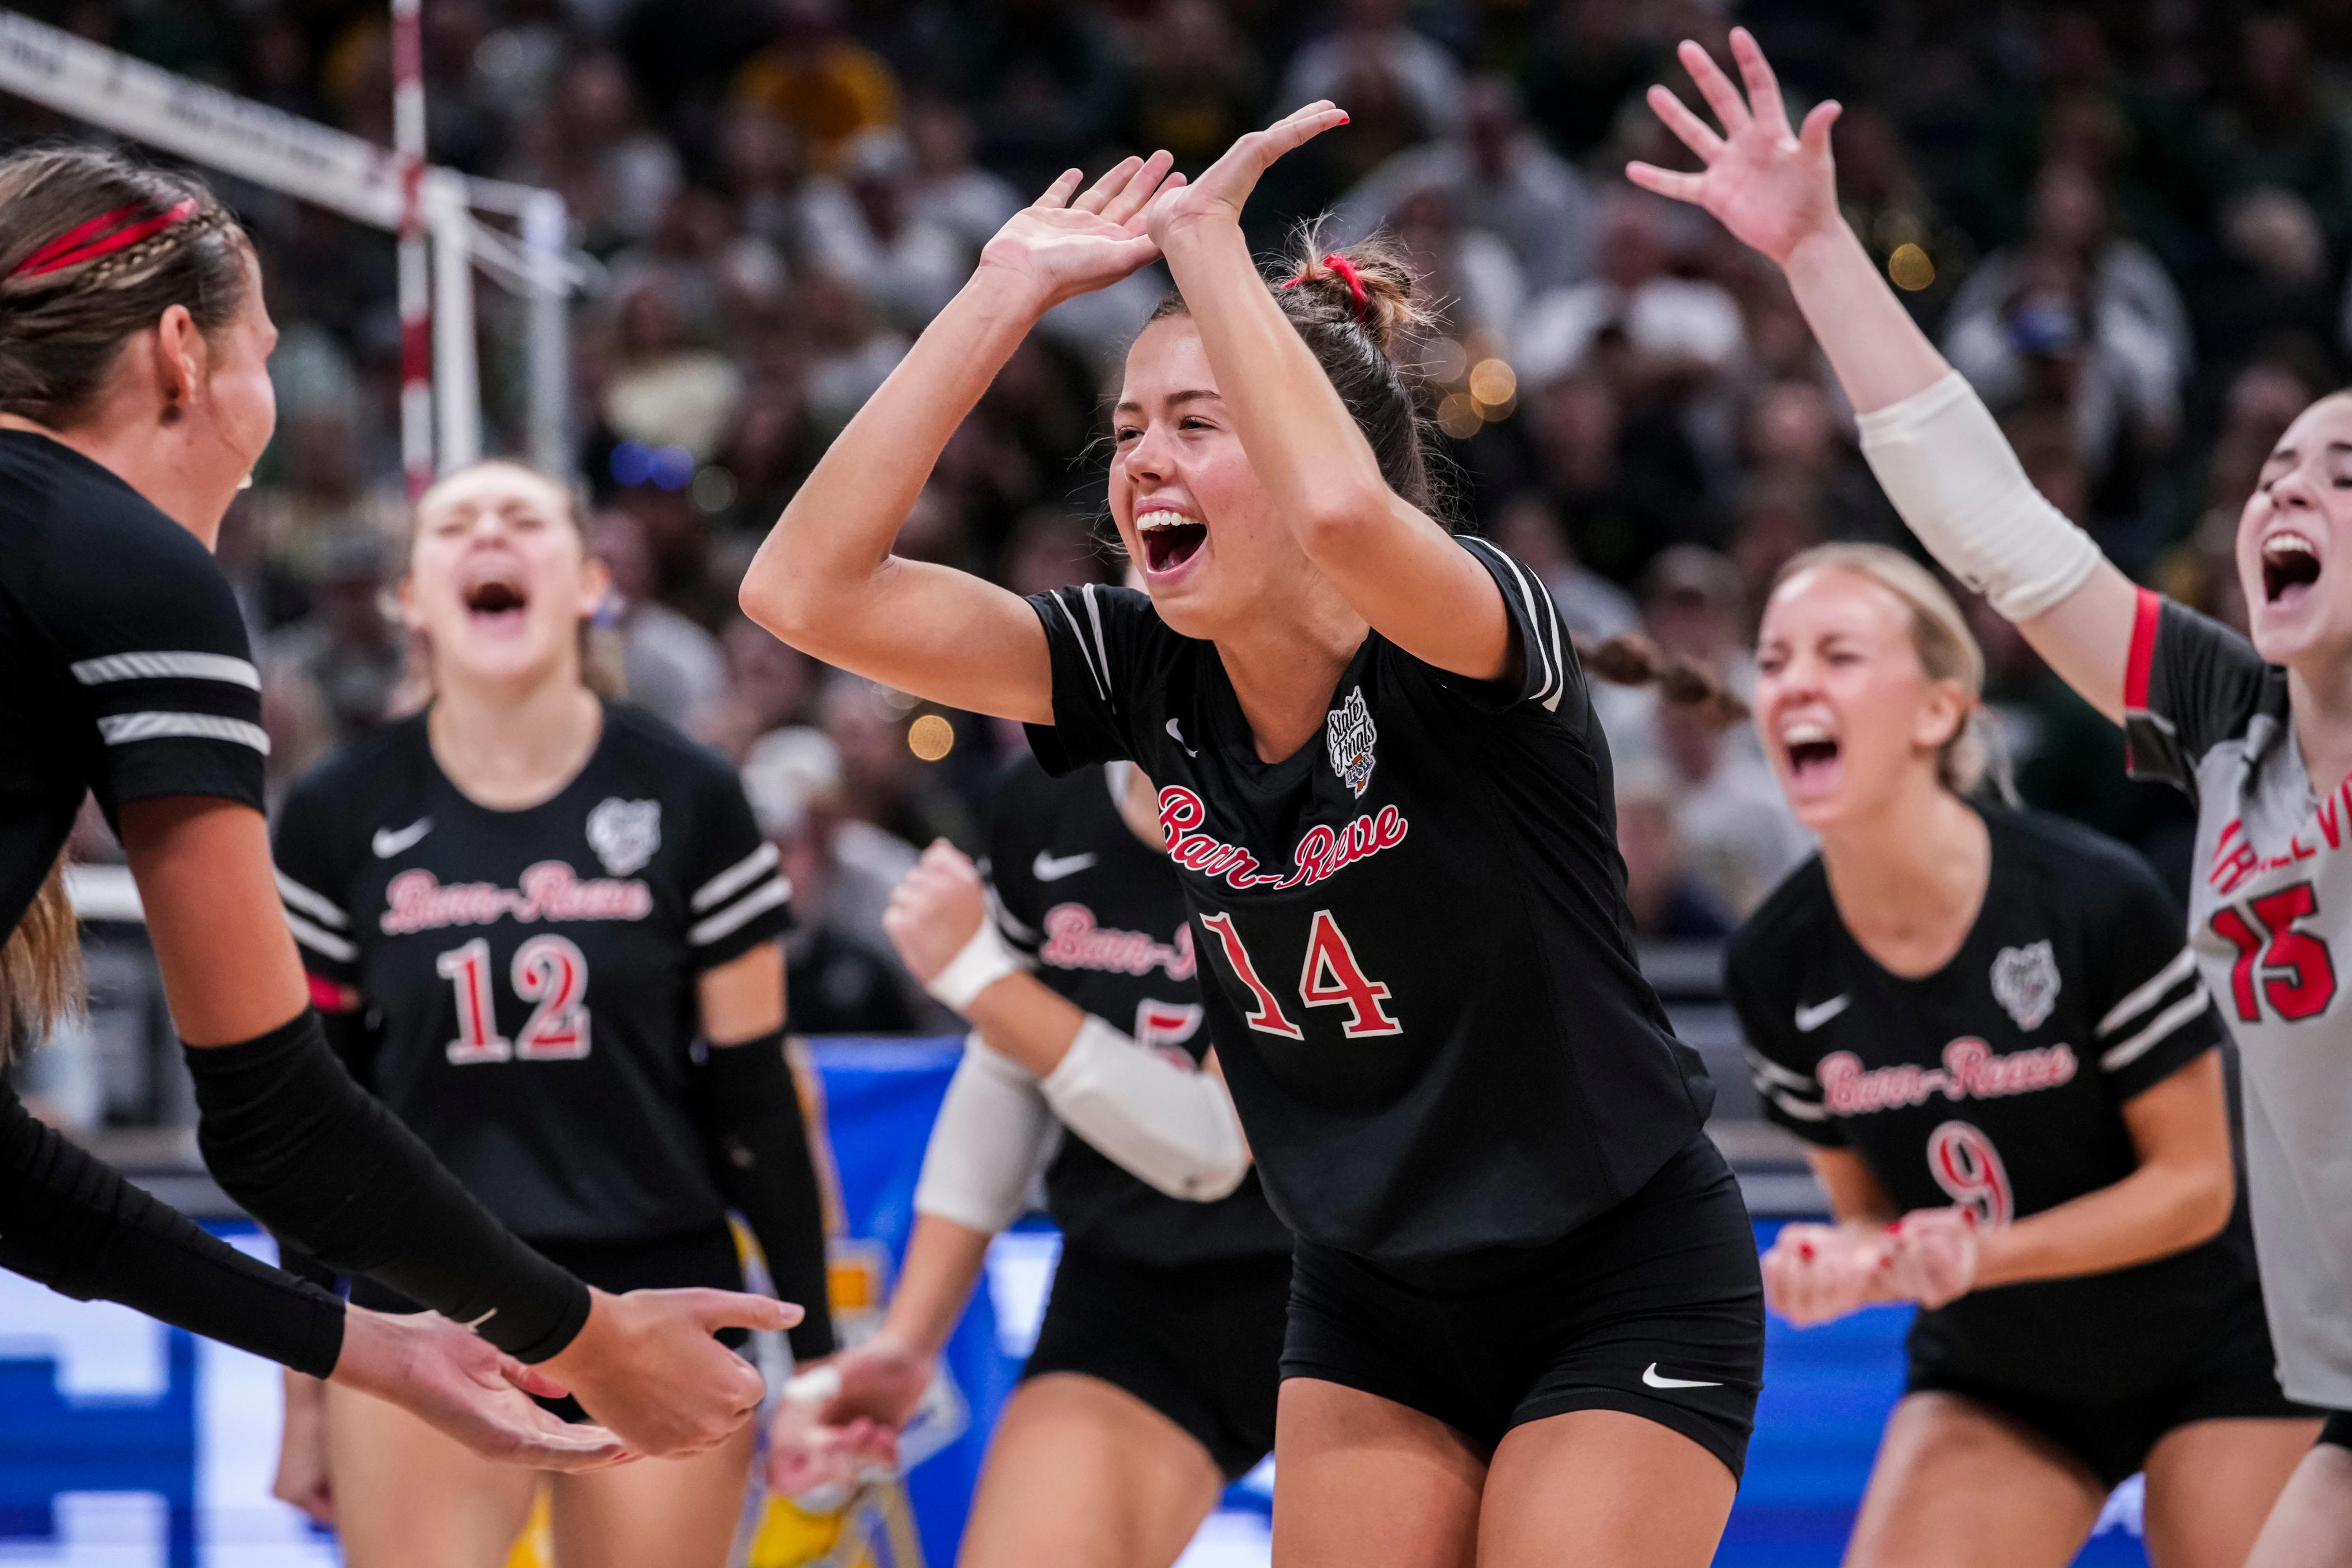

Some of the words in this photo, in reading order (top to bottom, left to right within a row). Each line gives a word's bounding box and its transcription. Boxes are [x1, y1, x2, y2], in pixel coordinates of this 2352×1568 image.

[1329, 691, 1364, 750] State
[1332, 715, 1374, 774] Finals
[1158, 785, 1408, 889] Barr-Reeve
[437, 932, 592, 1065] 12
[1199, 909, 1404, 1041] 14
[2209, 880, 2338, 1024] 15
[1926, 1120, 2015, 1230] 9
